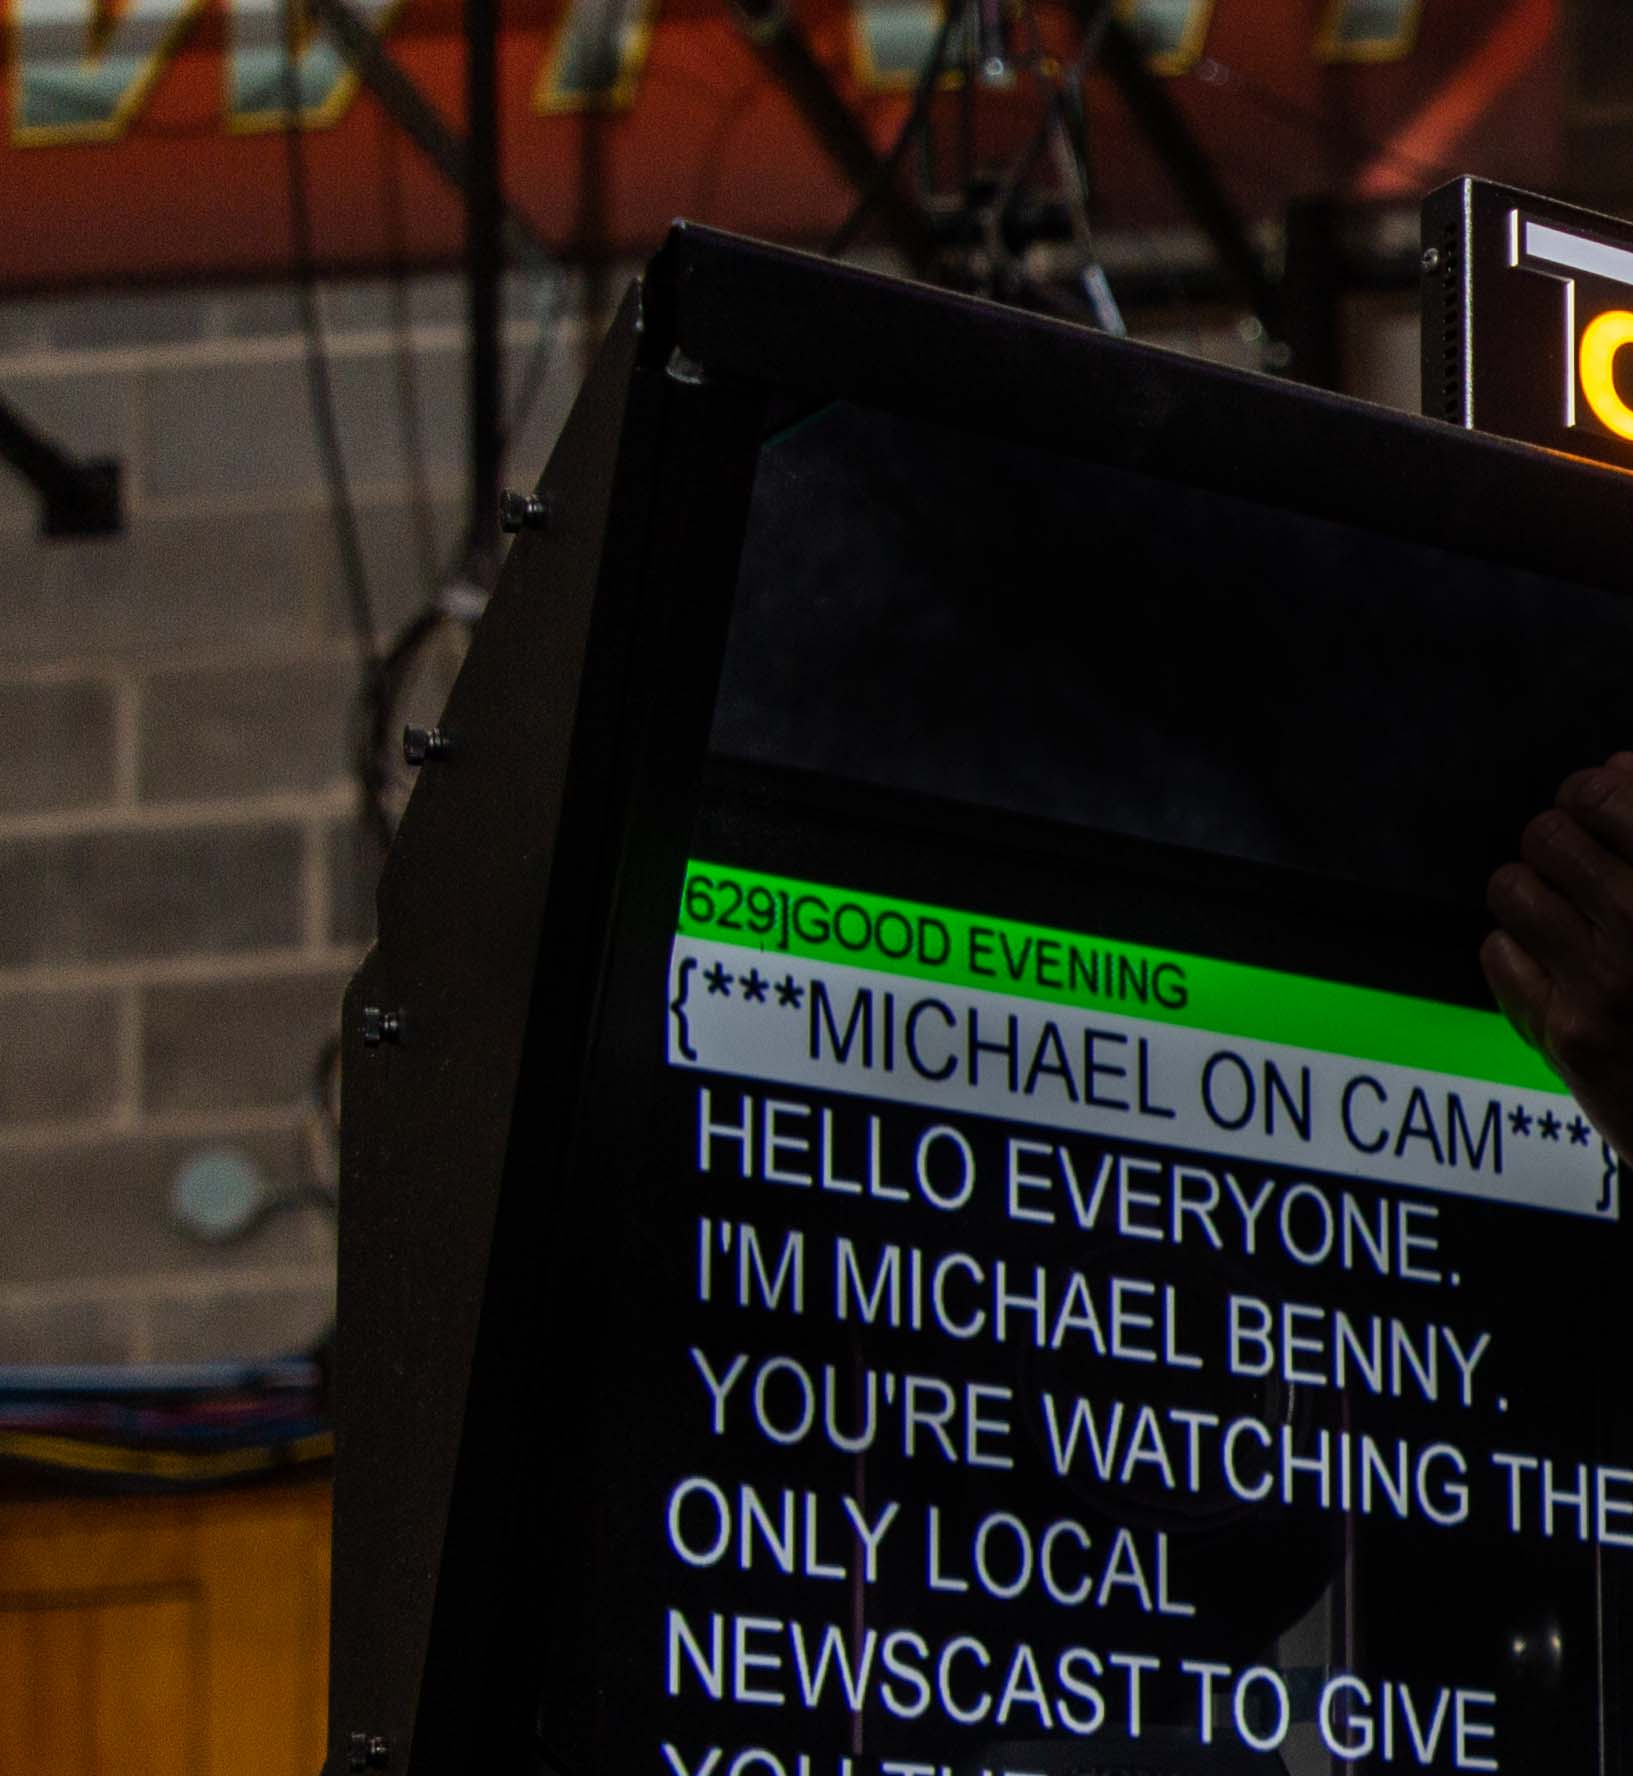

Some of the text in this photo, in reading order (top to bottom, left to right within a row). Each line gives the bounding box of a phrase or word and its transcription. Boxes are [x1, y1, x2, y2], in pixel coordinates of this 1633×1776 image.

[967, 926, 1189, 1010] EVENING
[1201, 1050, 1311, 1142] ON
[699, 1087, 1463, 1289] HELLO EVERYONE.
[700, 1217, 1508, 1411] I'M MICHAEL BENNY.
[692, 1347, 1014, 1469] YOU'RE
[1042, 1393, 1470, 1525] WATCHING
[667, 1476, 1196, 1616] ONLY LOCAL
[668, 1608, 1499, 1771] NEWSCAST TO GIVE
